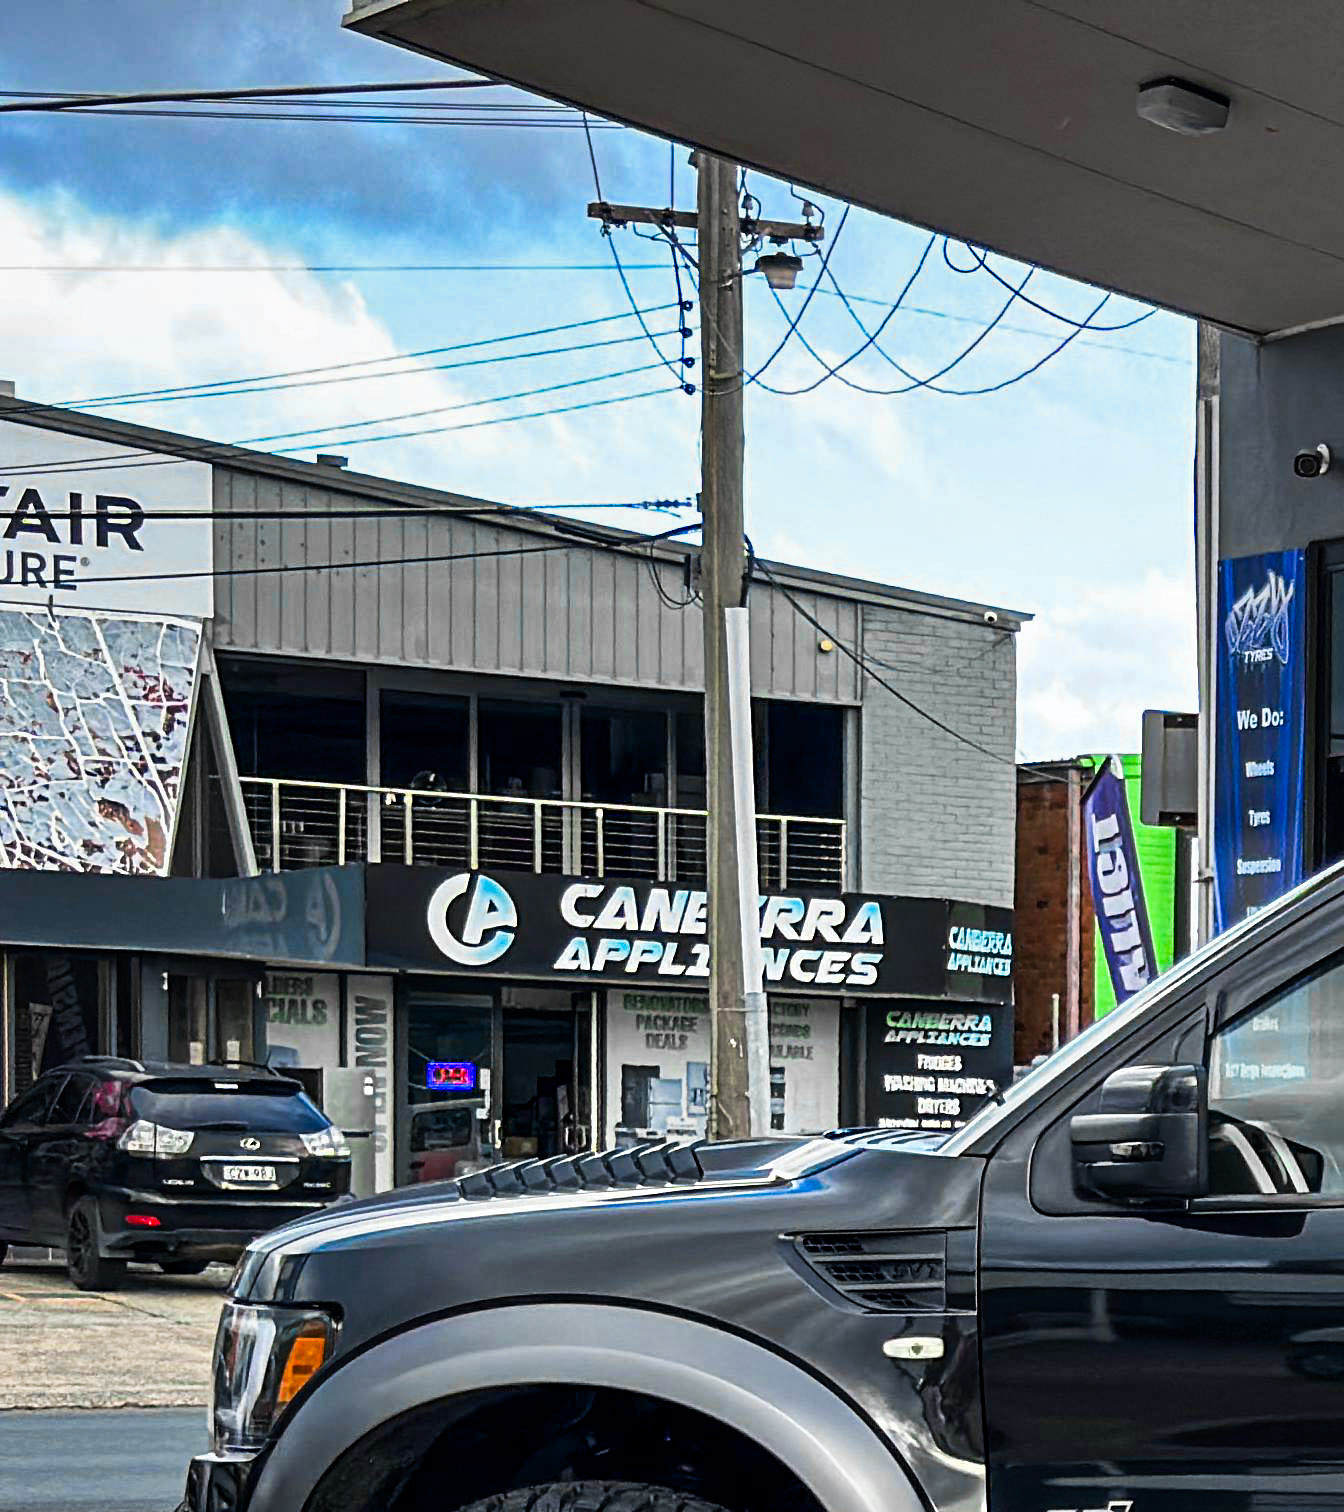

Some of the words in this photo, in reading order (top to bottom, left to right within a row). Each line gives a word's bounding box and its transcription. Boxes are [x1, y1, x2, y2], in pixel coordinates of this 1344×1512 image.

[0, 486, 144, 552] AIR
[1244, 647, 1274, 664] TYRES
[1236, 709, 1258, 730] We
[1261, 706, 1284, 728] Do:
[1245, 759, 1275, 778] Wheels
[1248, 809, 1271, 827] Tyres
[1236, 856, 1282, 875] Suspension
[560, 883, 884, 945] CANBRRA
[948, 925, 1013, 956] CANBERRA
[553, 936, 884, 986] APPLINCES
[947, 951, 1011, 976] APPLIANCES
[354, 995, 388, 1067] NOW
[886, 1010, 992, 1032] CANBERRA
[645, 1033, 688, 1050] DEALS
[883, 1029, 991, 1047] APPLIANCES
